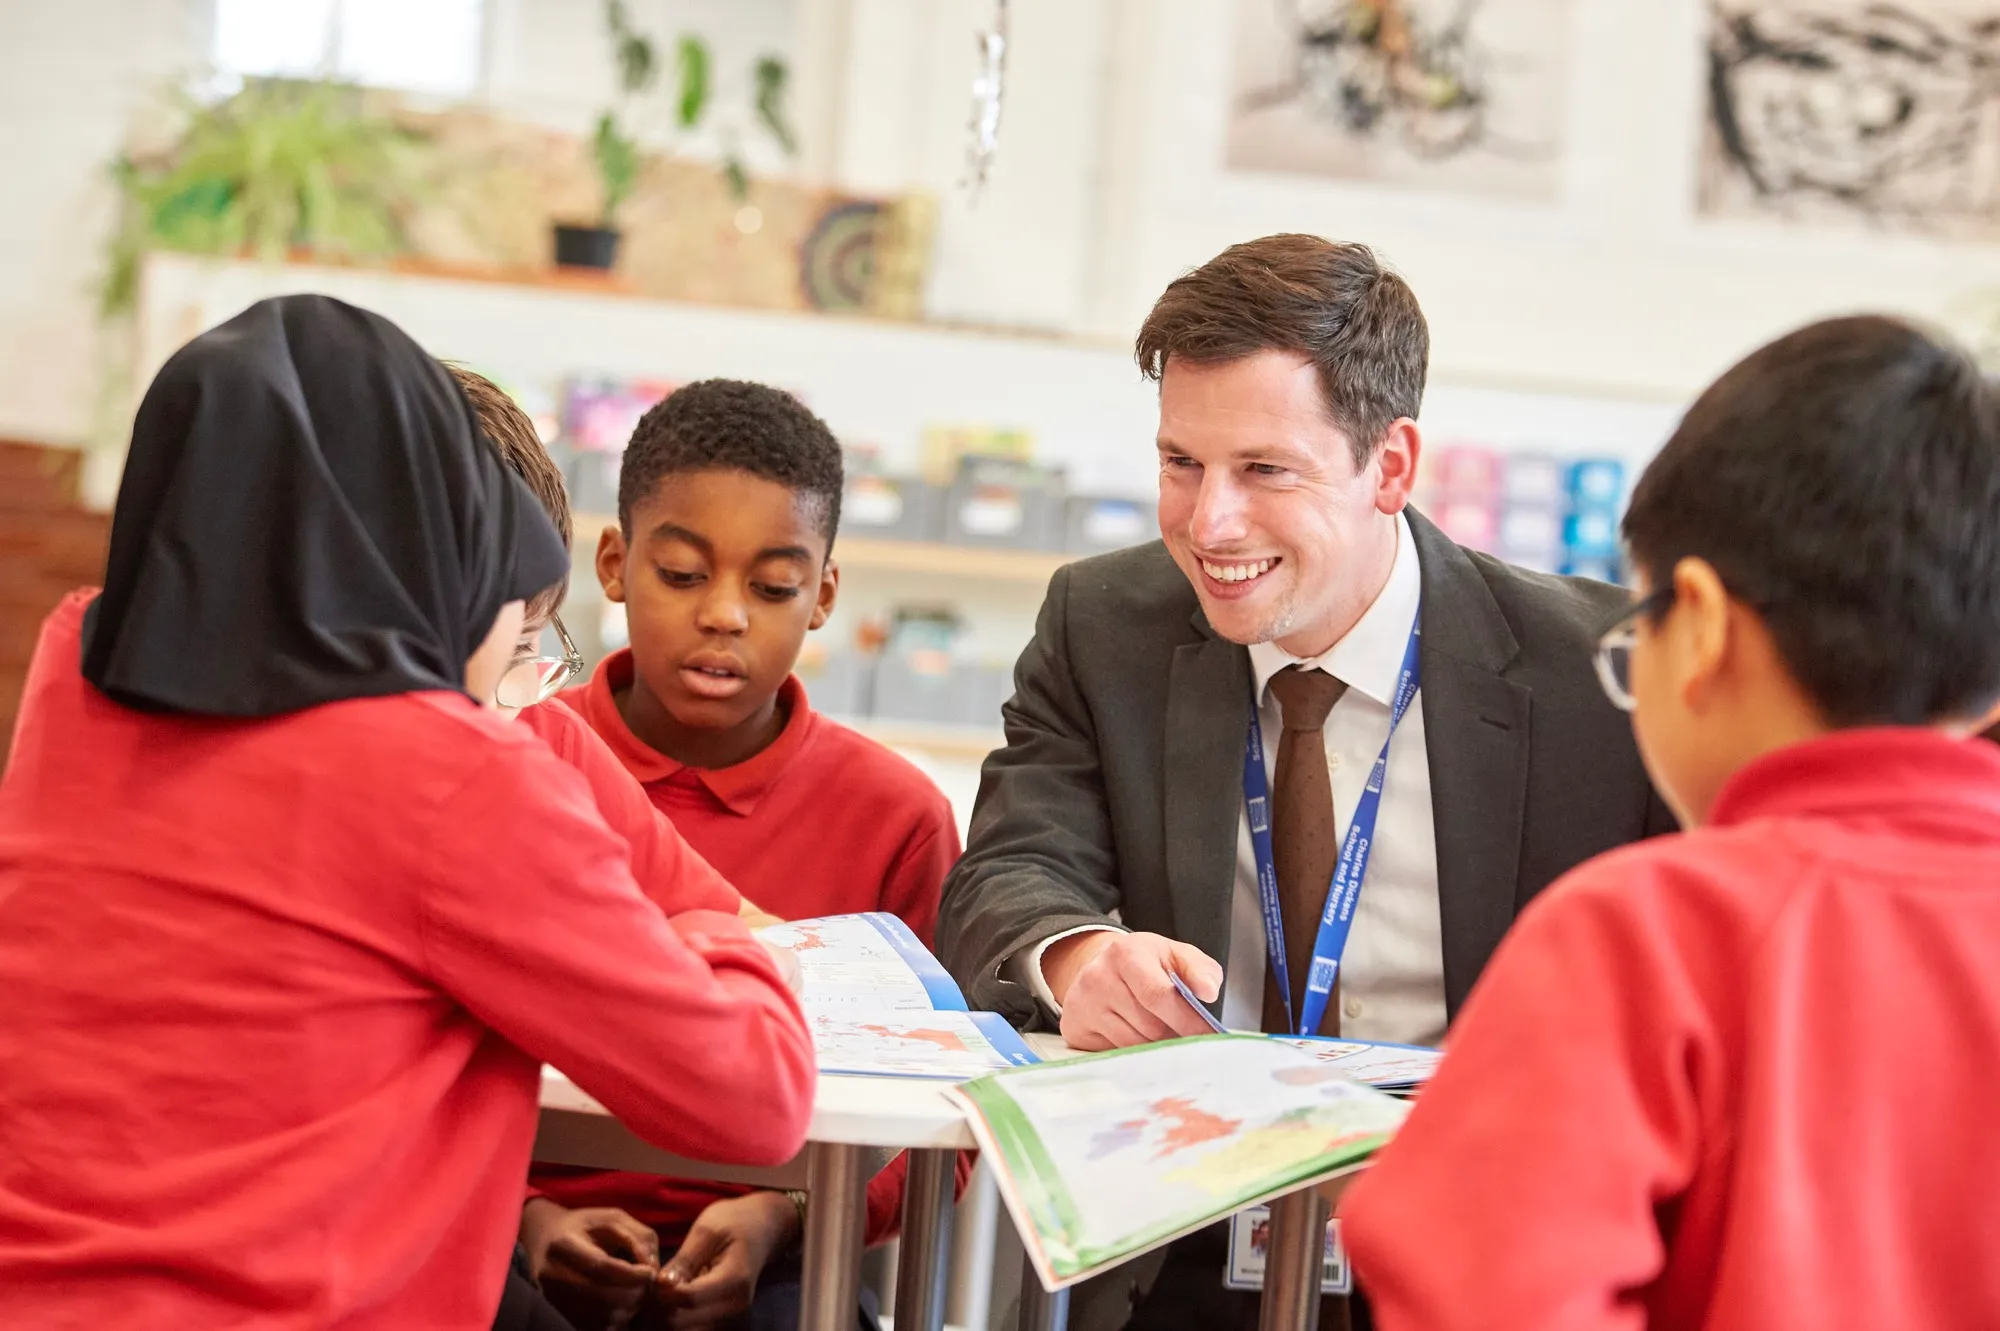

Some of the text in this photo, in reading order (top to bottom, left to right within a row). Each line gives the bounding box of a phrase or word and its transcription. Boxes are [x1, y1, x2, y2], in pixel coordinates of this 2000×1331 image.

[1396, 669, 1411, 706] School
[1323, 824, 1361, 926] School and Nursery
[1339, 838, 1369, 921] Charles Dickens
